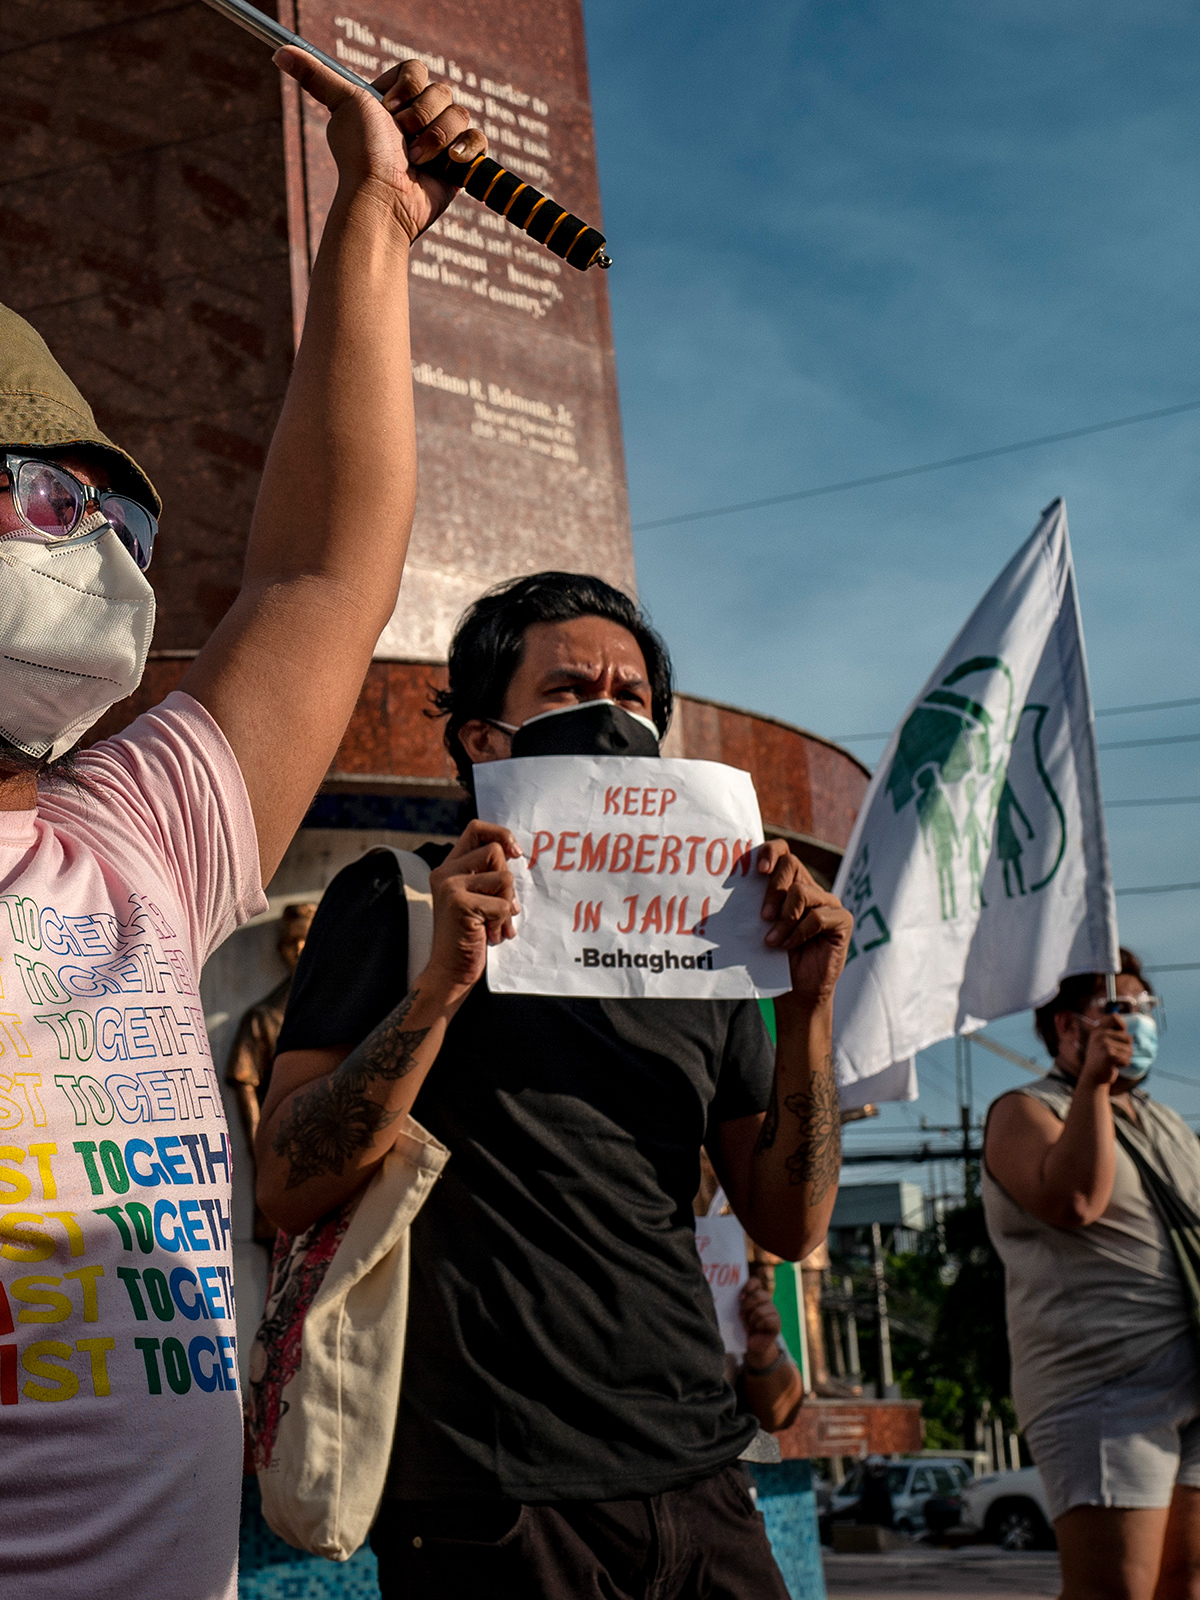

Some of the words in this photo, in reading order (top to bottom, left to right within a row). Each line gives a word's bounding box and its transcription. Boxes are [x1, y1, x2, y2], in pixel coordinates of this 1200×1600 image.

[603, 786, 676, 817] KEEP
[527, 830, 752, 877] PEMBERTON
[572, 899, 603, 933] IN
[617, 895, 711, 936] JAIL!
[574, 948, 713, 974] -Bahaghari
[55, 1068, 225, 1126] TOGETH
[75, 1132, 232, 1195] TOGETH
